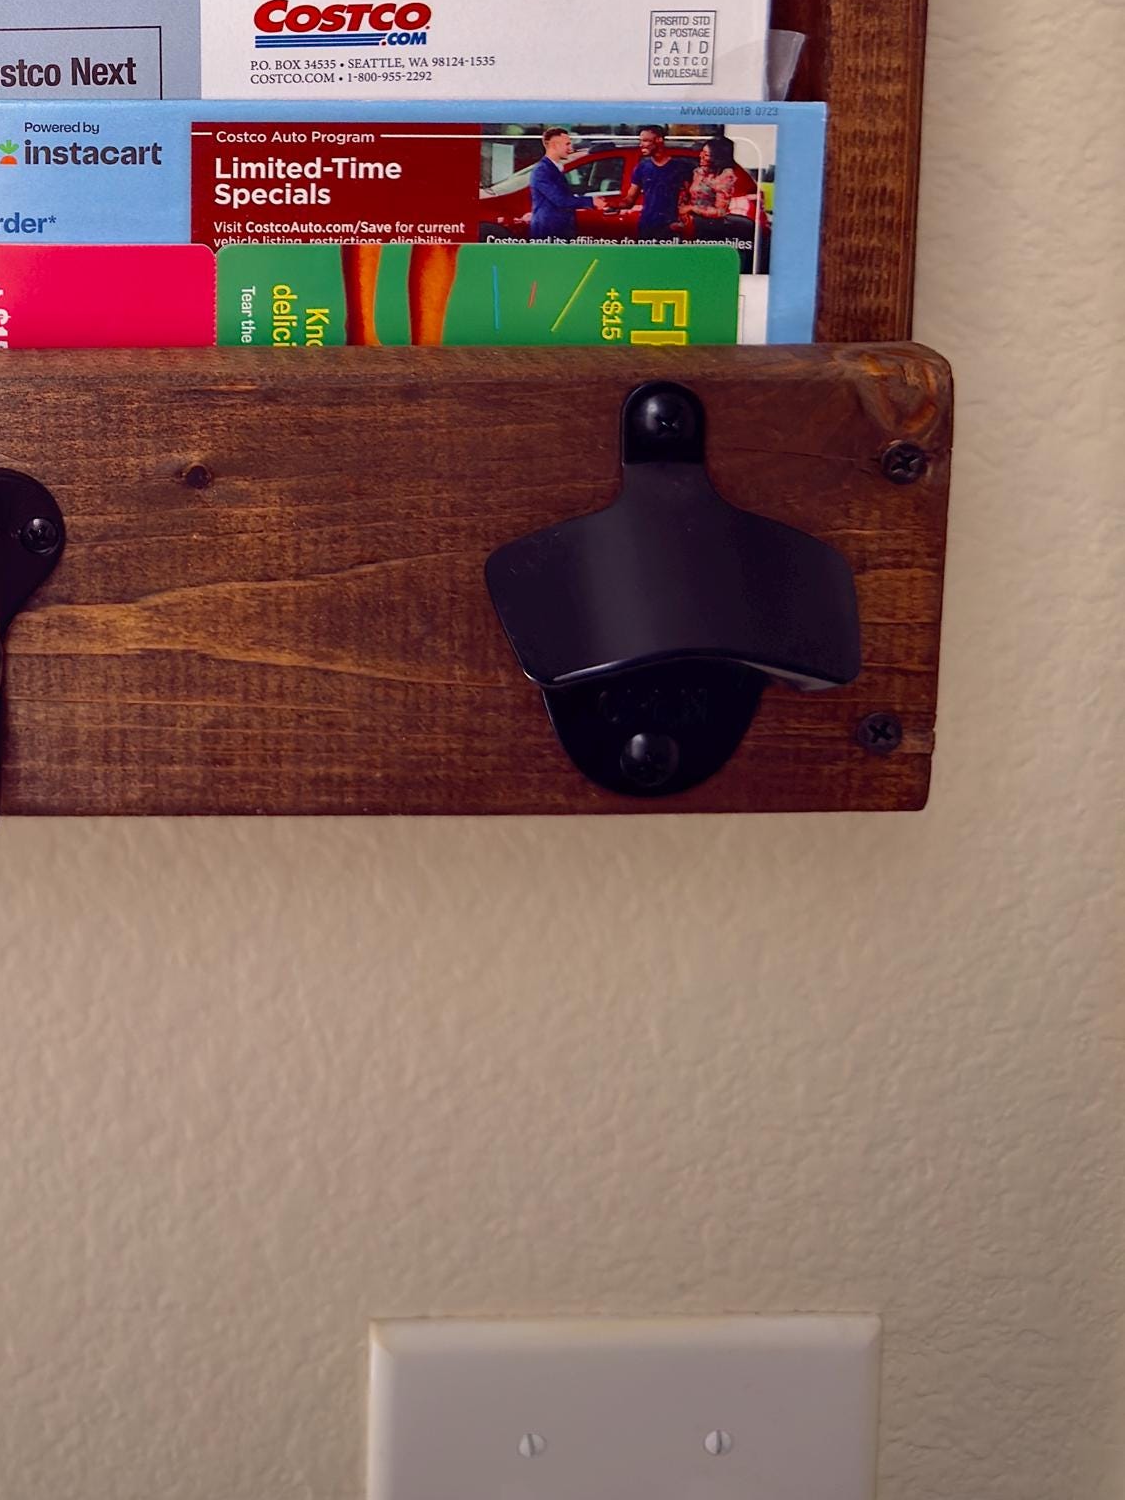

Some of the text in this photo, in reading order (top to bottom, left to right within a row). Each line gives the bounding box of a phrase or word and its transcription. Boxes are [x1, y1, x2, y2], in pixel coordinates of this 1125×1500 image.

[254, 0, 432, 32] COSTCO
[692, 16, 711, 26] STD
[381, 32, 427, 46] .COM
[654, 27, 711, 38] US POSTAGE
[250, 56, 496, 71] P.O. BOX 34535 SEATTLE, WA 98124-1535
[653, 56, 709, 67] COSTCO
[71, 57, 137, 86] Next
[250, 71, 432, 84] COSTCO.COM 1-800-955-2292
[652, 68, 709, 78] WHOLESALE
[24, 122, 100, 136] Powered by
[216, 131, 375, 145] Costco Auto Program
[24, 140, 163, 166] instacart
[215, 157, 403, 179] Limited-Time
[215, 183, 332, 209] Specials
[213, 220, 465, 235] Visit CostcoAuto.com/Save for current
[241, 285, 256, 344] Tear the
